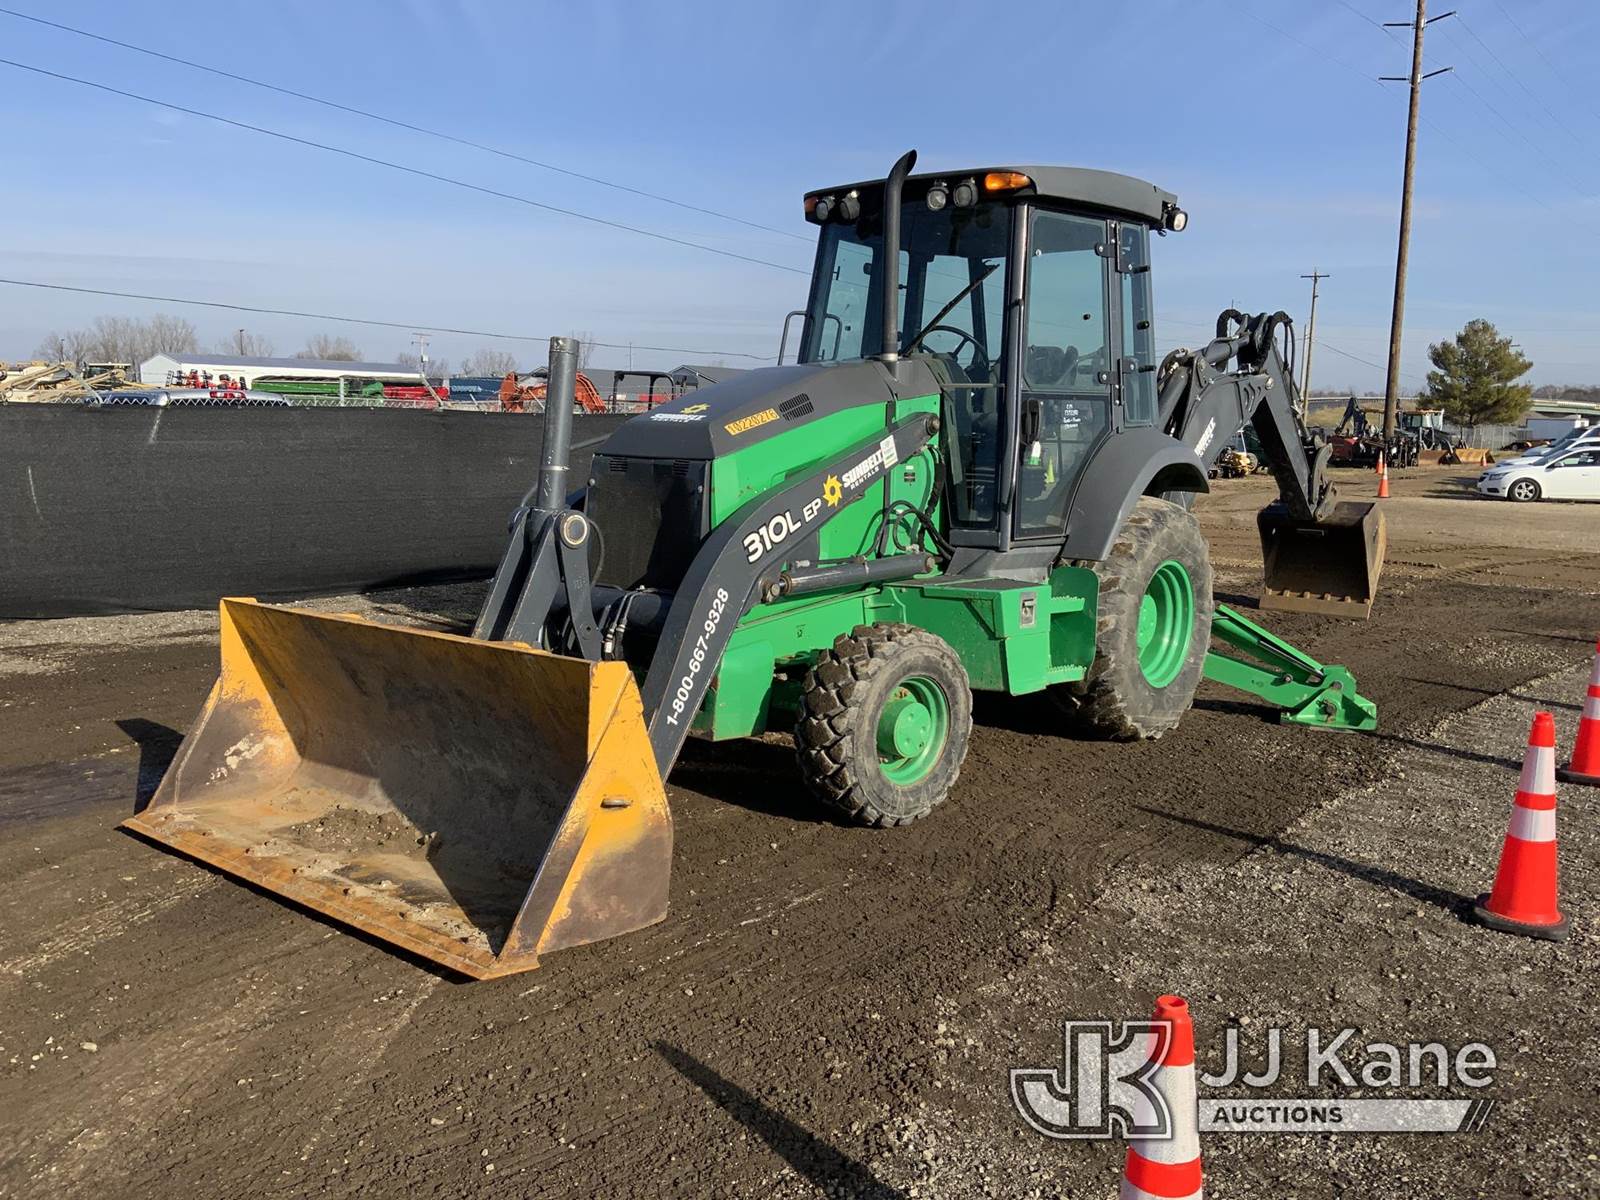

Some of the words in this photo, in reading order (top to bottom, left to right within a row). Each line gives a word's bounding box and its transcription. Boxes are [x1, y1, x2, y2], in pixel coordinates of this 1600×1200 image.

[742, 510, 802, 563] 310L
[803, 497, 822, 522] EP
[666, 588, 729, 726] 1-800-667-9328
